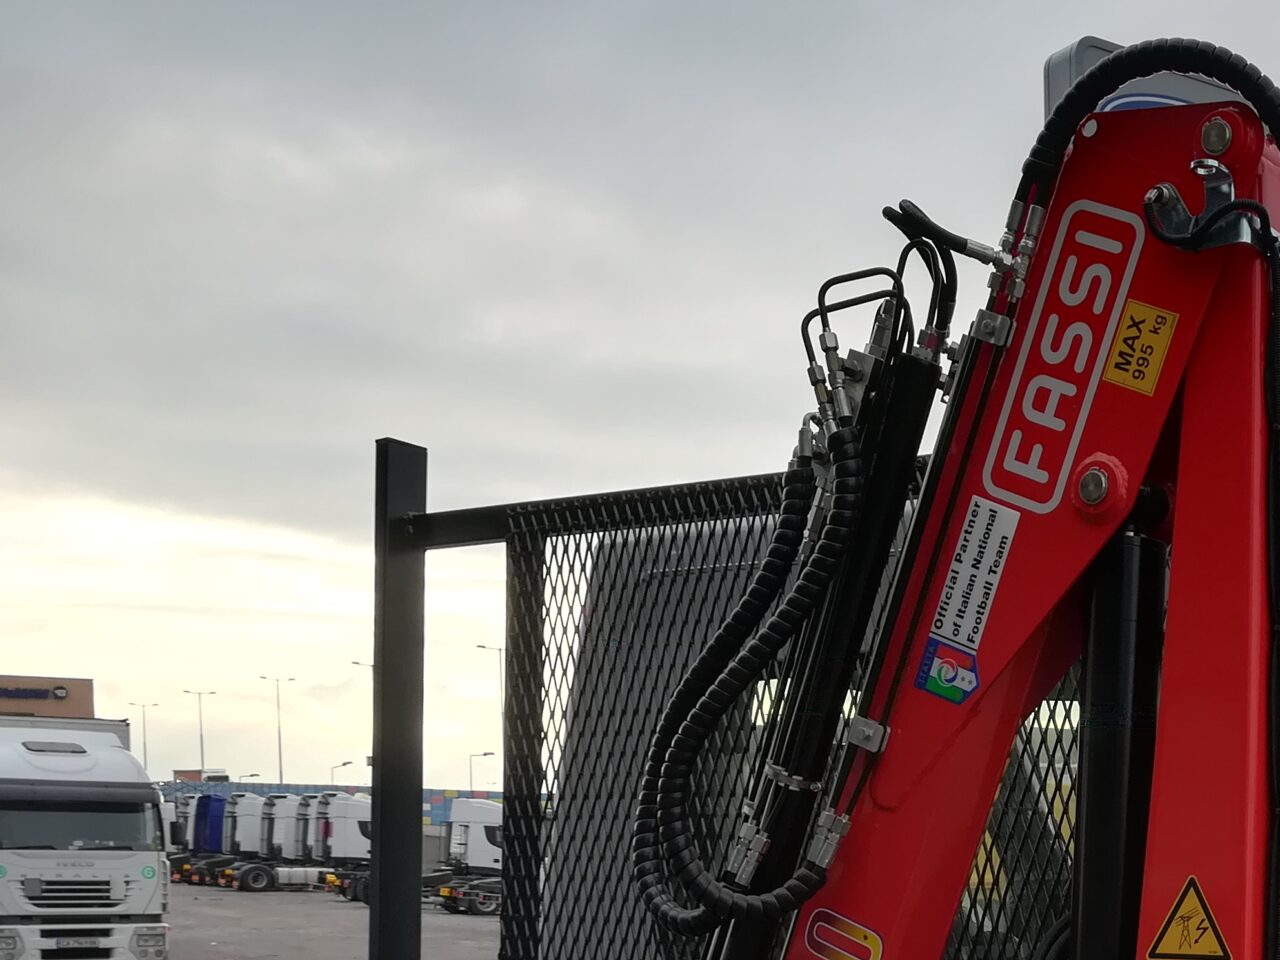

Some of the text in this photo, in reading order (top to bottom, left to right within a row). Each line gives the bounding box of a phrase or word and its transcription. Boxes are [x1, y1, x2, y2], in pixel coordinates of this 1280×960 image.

[1003, 228, 1123, 484] FASSI
[1113, 314, 1146, 373] MAX
[1132, 314, 1167, 381] 995 kg
[934, 501, 981, 630] Official Partner
[952, 508, 998, 637] of Italian National
[967, 534, 1009, 644] Football Team
[919, 645, 936, 684] ITALIA
